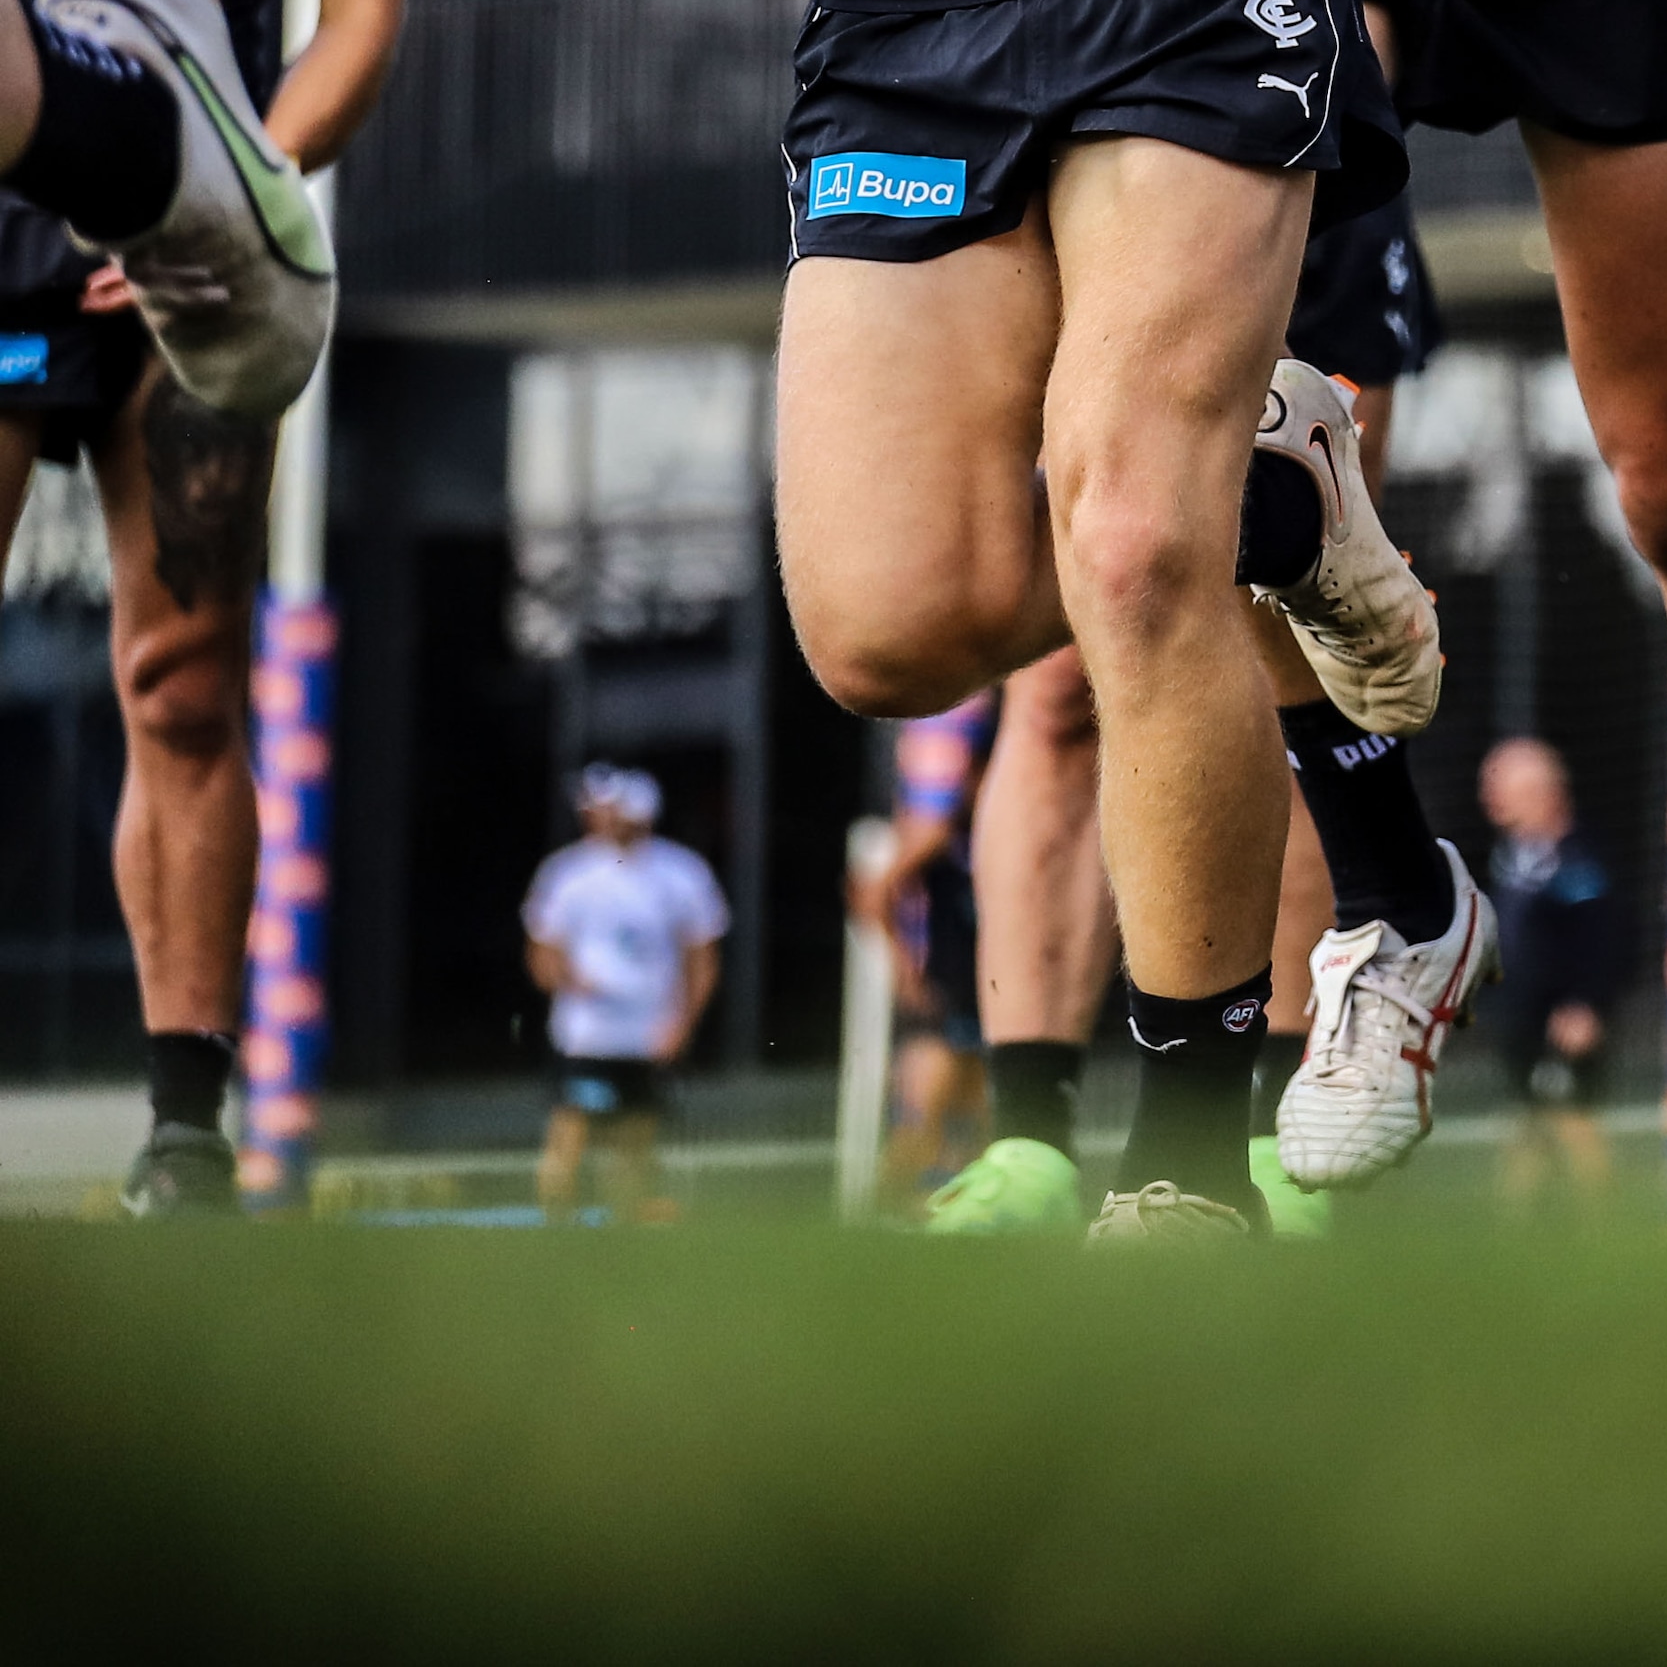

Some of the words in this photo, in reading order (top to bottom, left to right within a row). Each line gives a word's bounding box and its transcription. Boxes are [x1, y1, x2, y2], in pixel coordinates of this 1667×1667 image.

[857, 170, 955, 207] Bupa
[1332, 733, 1397, 770] PU
[1226, 1007, 1255, 1022] AFL
